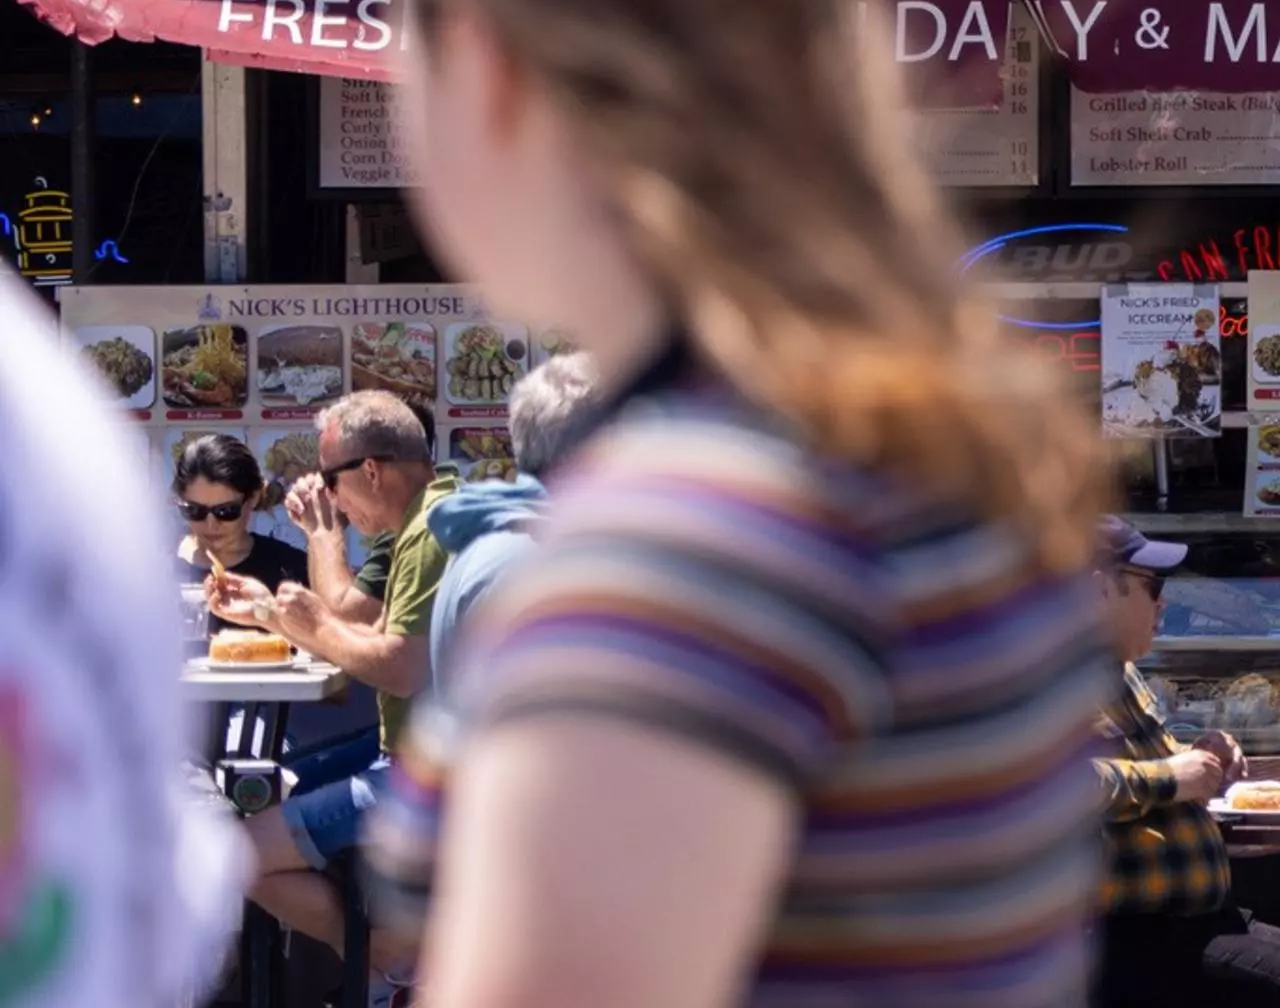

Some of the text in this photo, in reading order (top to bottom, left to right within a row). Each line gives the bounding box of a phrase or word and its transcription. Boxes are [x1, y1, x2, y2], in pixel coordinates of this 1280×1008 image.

[896, 0, 1107, 63] DAY
[1135, 8, 1170, 50] &
[1192, 96, 1237, 112] Steak
[341, 135, 387, 149] Onion
[1089, 126, 1122, 142] Soft
[1172, 126, 1212, 142] Crab
[341, 151, 376, 165] Corn
[1154, 156, 1187, 171] Roll
[1012, 241, 1134, 271] BUD
[228, 296, 464, 317] NICK'S LIGHTHOUSE
[1120, 296, 1199, 309] NICK'S FRIED
